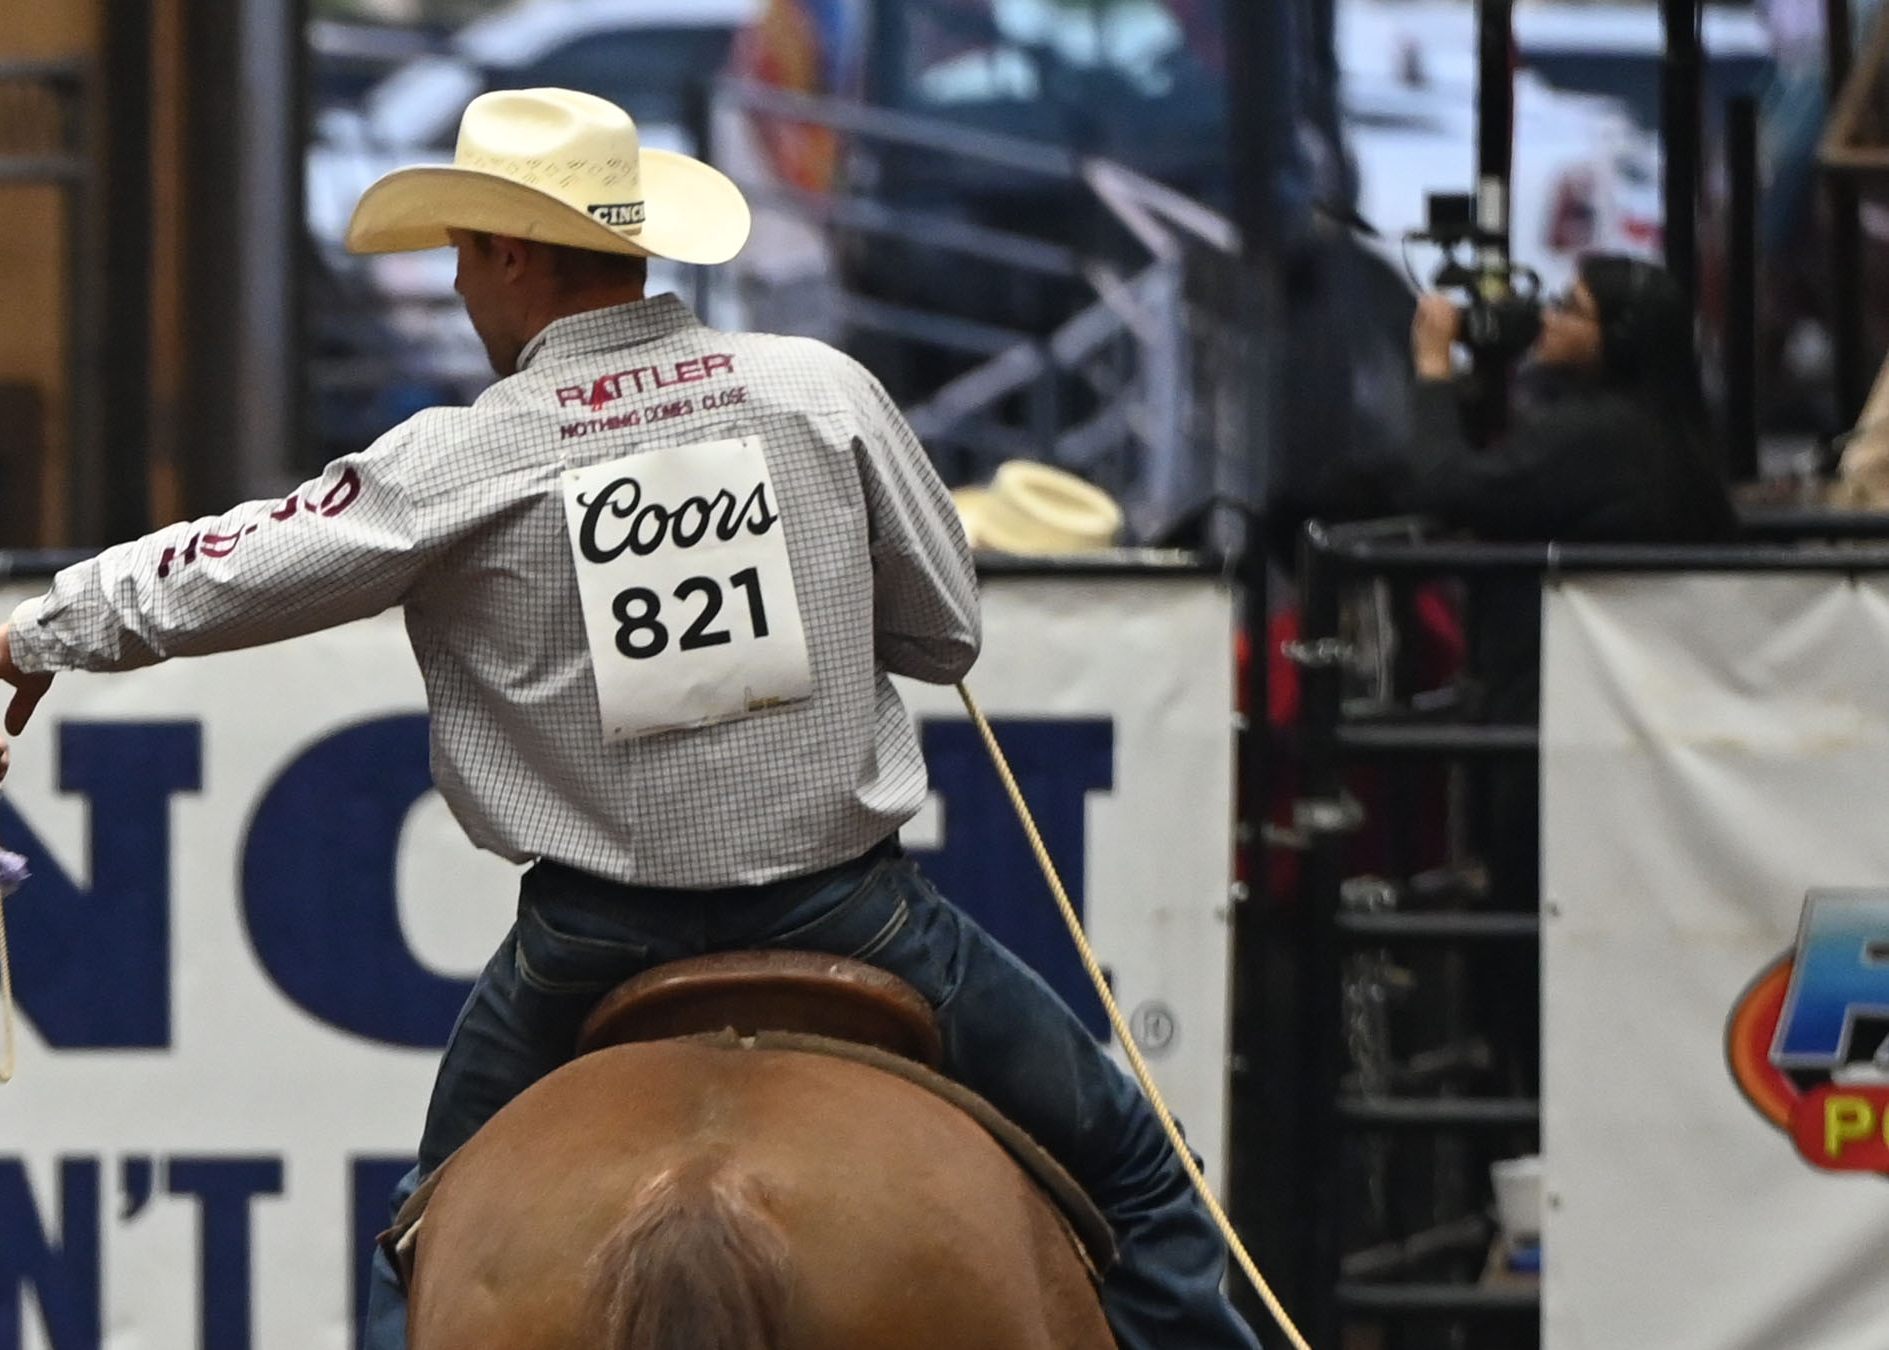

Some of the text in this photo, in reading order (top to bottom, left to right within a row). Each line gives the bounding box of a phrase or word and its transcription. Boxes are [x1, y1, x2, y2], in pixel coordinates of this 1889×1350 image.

[561, 386, 750, 439] NOTHING COMES CLOSE
[576, 477, 778, 564] Coors
[612, 566, 769, 659] 821
